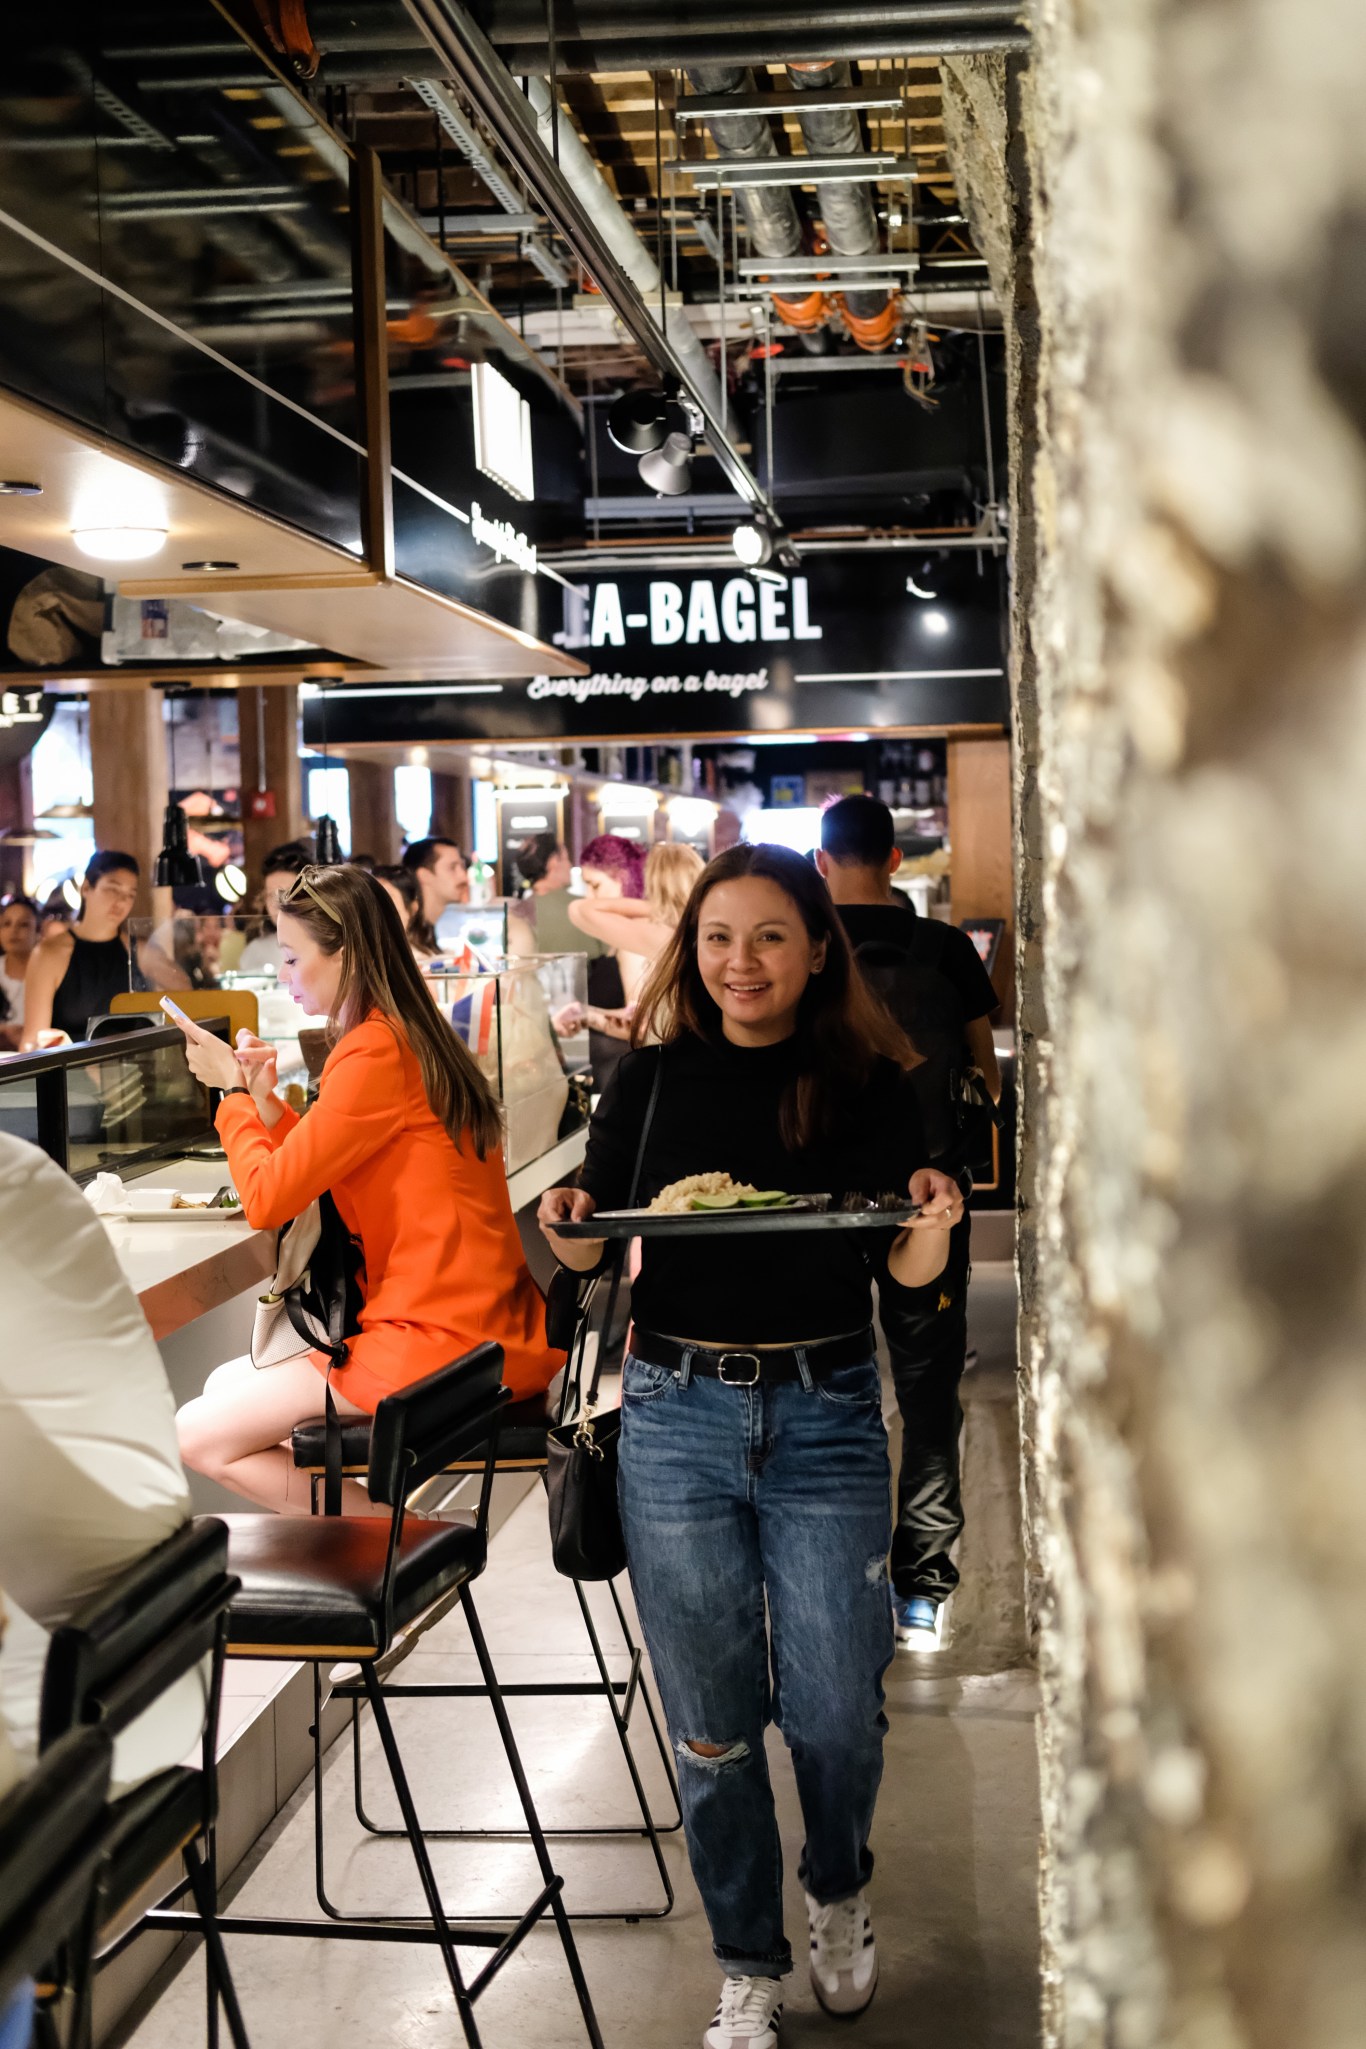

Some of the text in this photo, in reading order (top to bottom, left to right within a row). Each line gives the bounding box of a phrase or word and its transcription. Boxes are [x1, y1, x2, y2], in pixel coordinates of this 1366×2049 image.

[526, 667, 769, 703] Everything on a bagel
